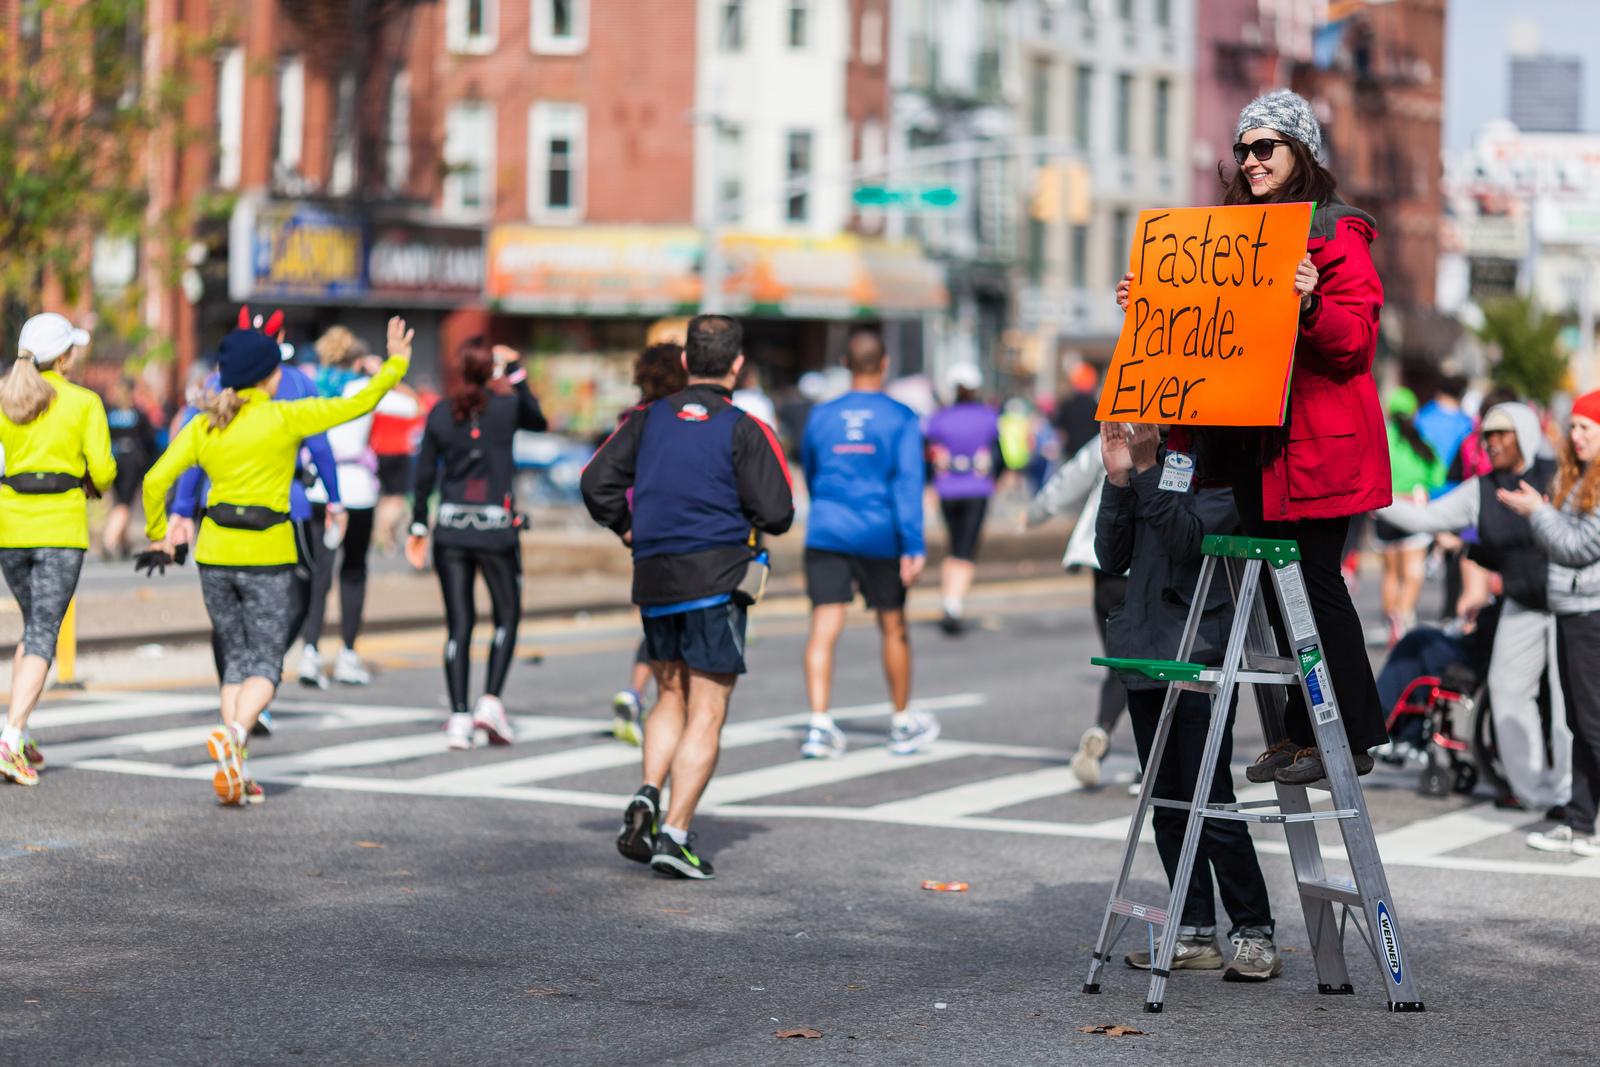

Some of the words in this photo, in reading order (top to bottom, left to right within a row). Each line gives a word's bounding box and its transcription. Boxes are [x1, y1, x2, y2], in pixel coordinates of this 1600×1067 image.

[1139, 211, 1274, 287] Fastest.
[1131, 296, 1244, 360] Parade.
[1109, 359, 1206, 420] Ever.
[1177, 480, 1188, 488] 09
[1381, 918, 1399, 969] WERNER
